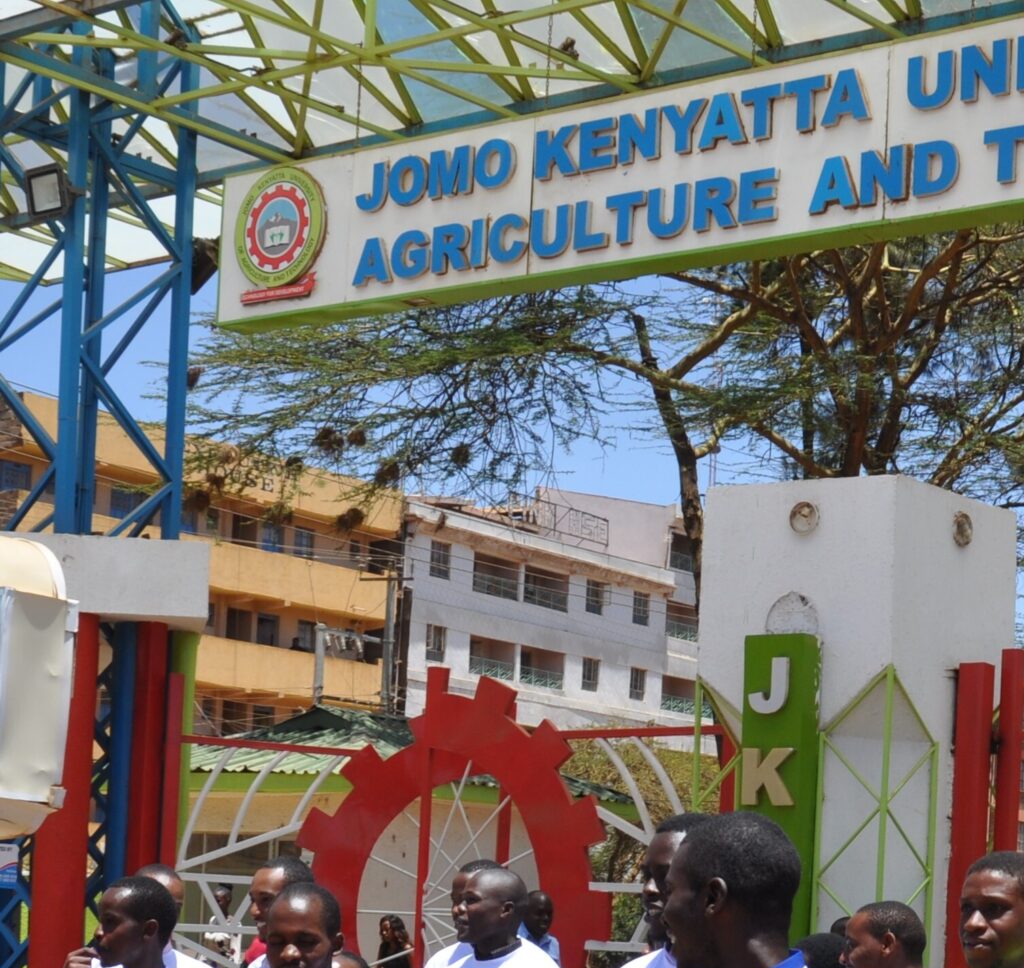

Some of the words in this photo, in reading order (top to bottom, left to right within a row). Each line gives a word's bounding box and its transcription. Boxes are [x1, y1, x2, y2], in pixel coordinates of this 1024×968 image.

[352, 167, 781, 287] AGRICULTURE
[809, 138, 960, 216] AND
[355, 138, 516, 213] JOMO
[533, 69, 872, 182] KENYATTA
